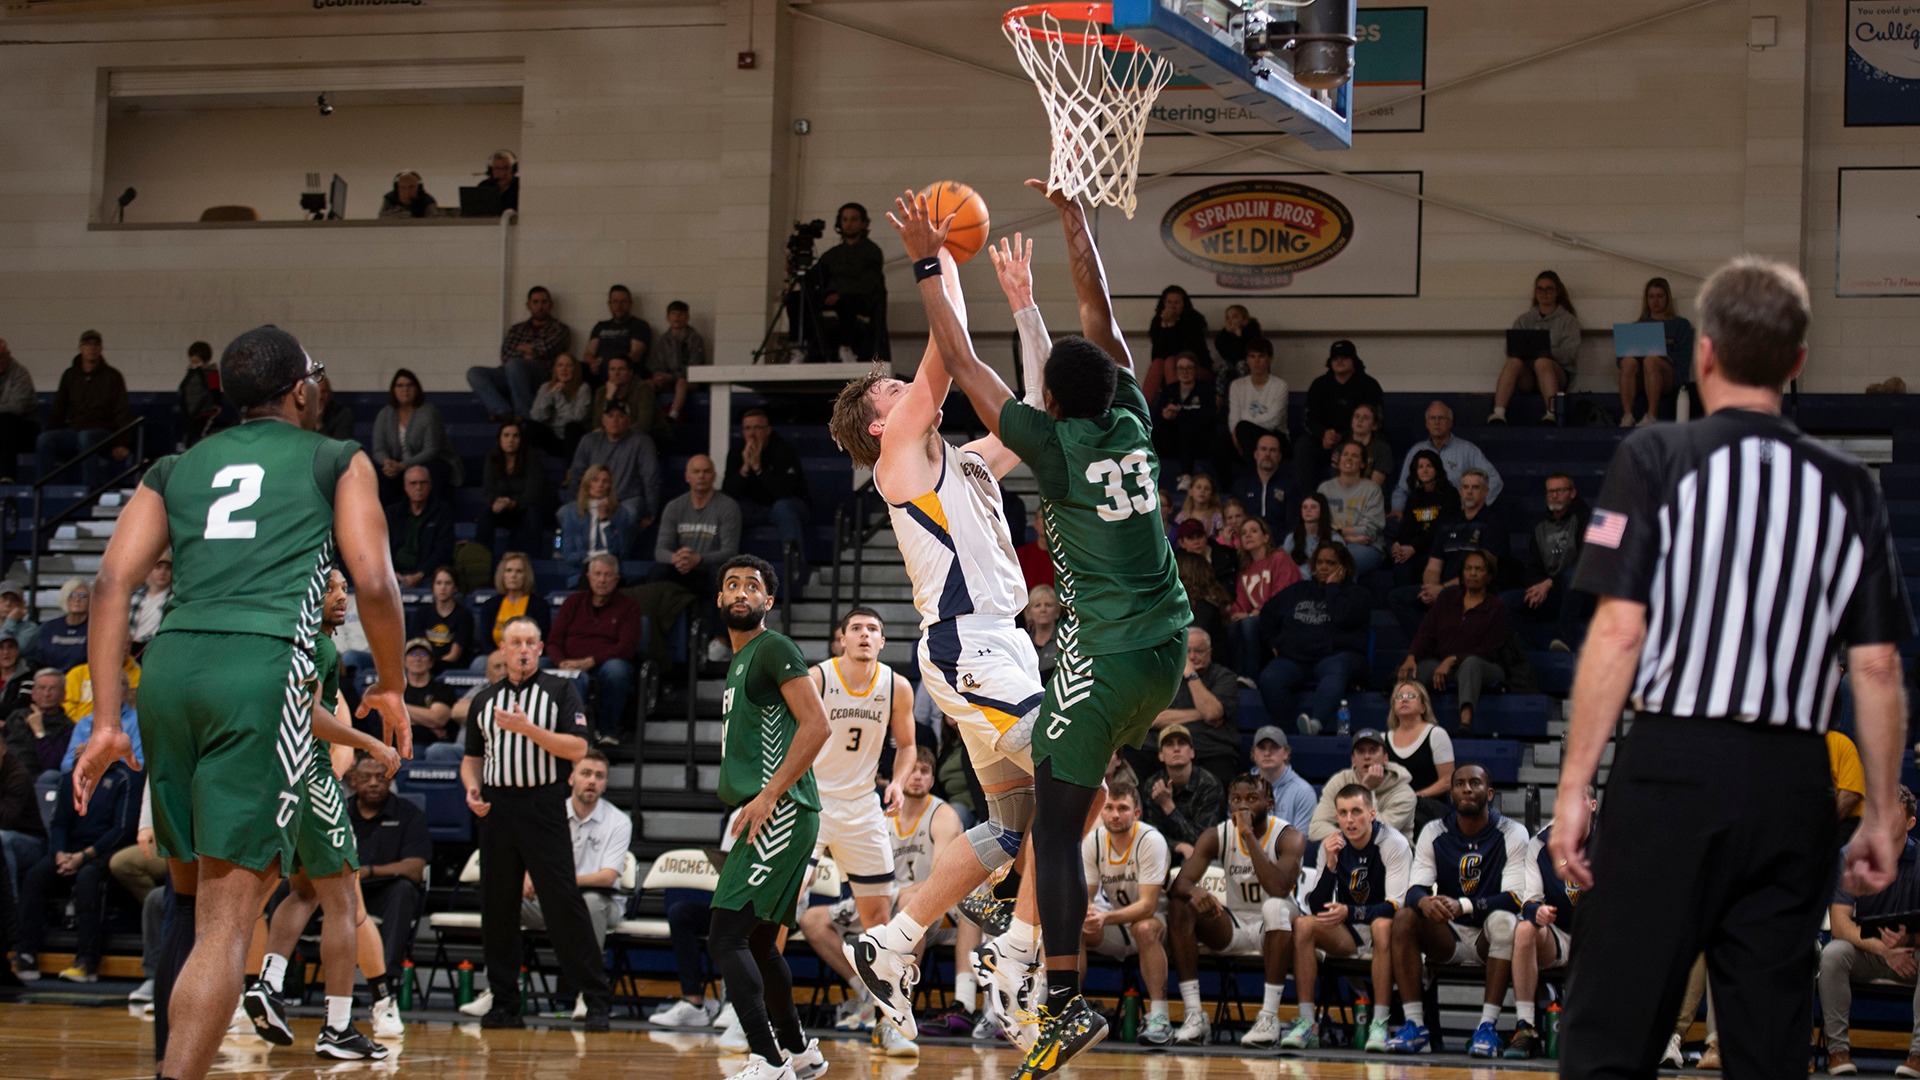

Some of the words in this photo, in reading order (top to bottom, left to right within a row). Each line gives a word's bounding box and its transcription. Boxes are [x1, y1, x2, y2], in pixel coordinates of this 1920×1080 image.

[1858, 7, 1874, 15] You
[1876, 6, 1900, 15] could
[1195, 200, 1269, 229] SPRADLIN
[1273, 200, 1316, 229] BROS.
[1201, 228, 1311, 254] WELDING
[1085, 449, 1157, 521] 33
[204, 463, 265, 540] 2
[830, 708, 883, 723] CEDARVILLE
[846, 727, 862, 752] 3
[1116, 889, 1130, 907] 0
[1240, 882, 1262, 902] 10
